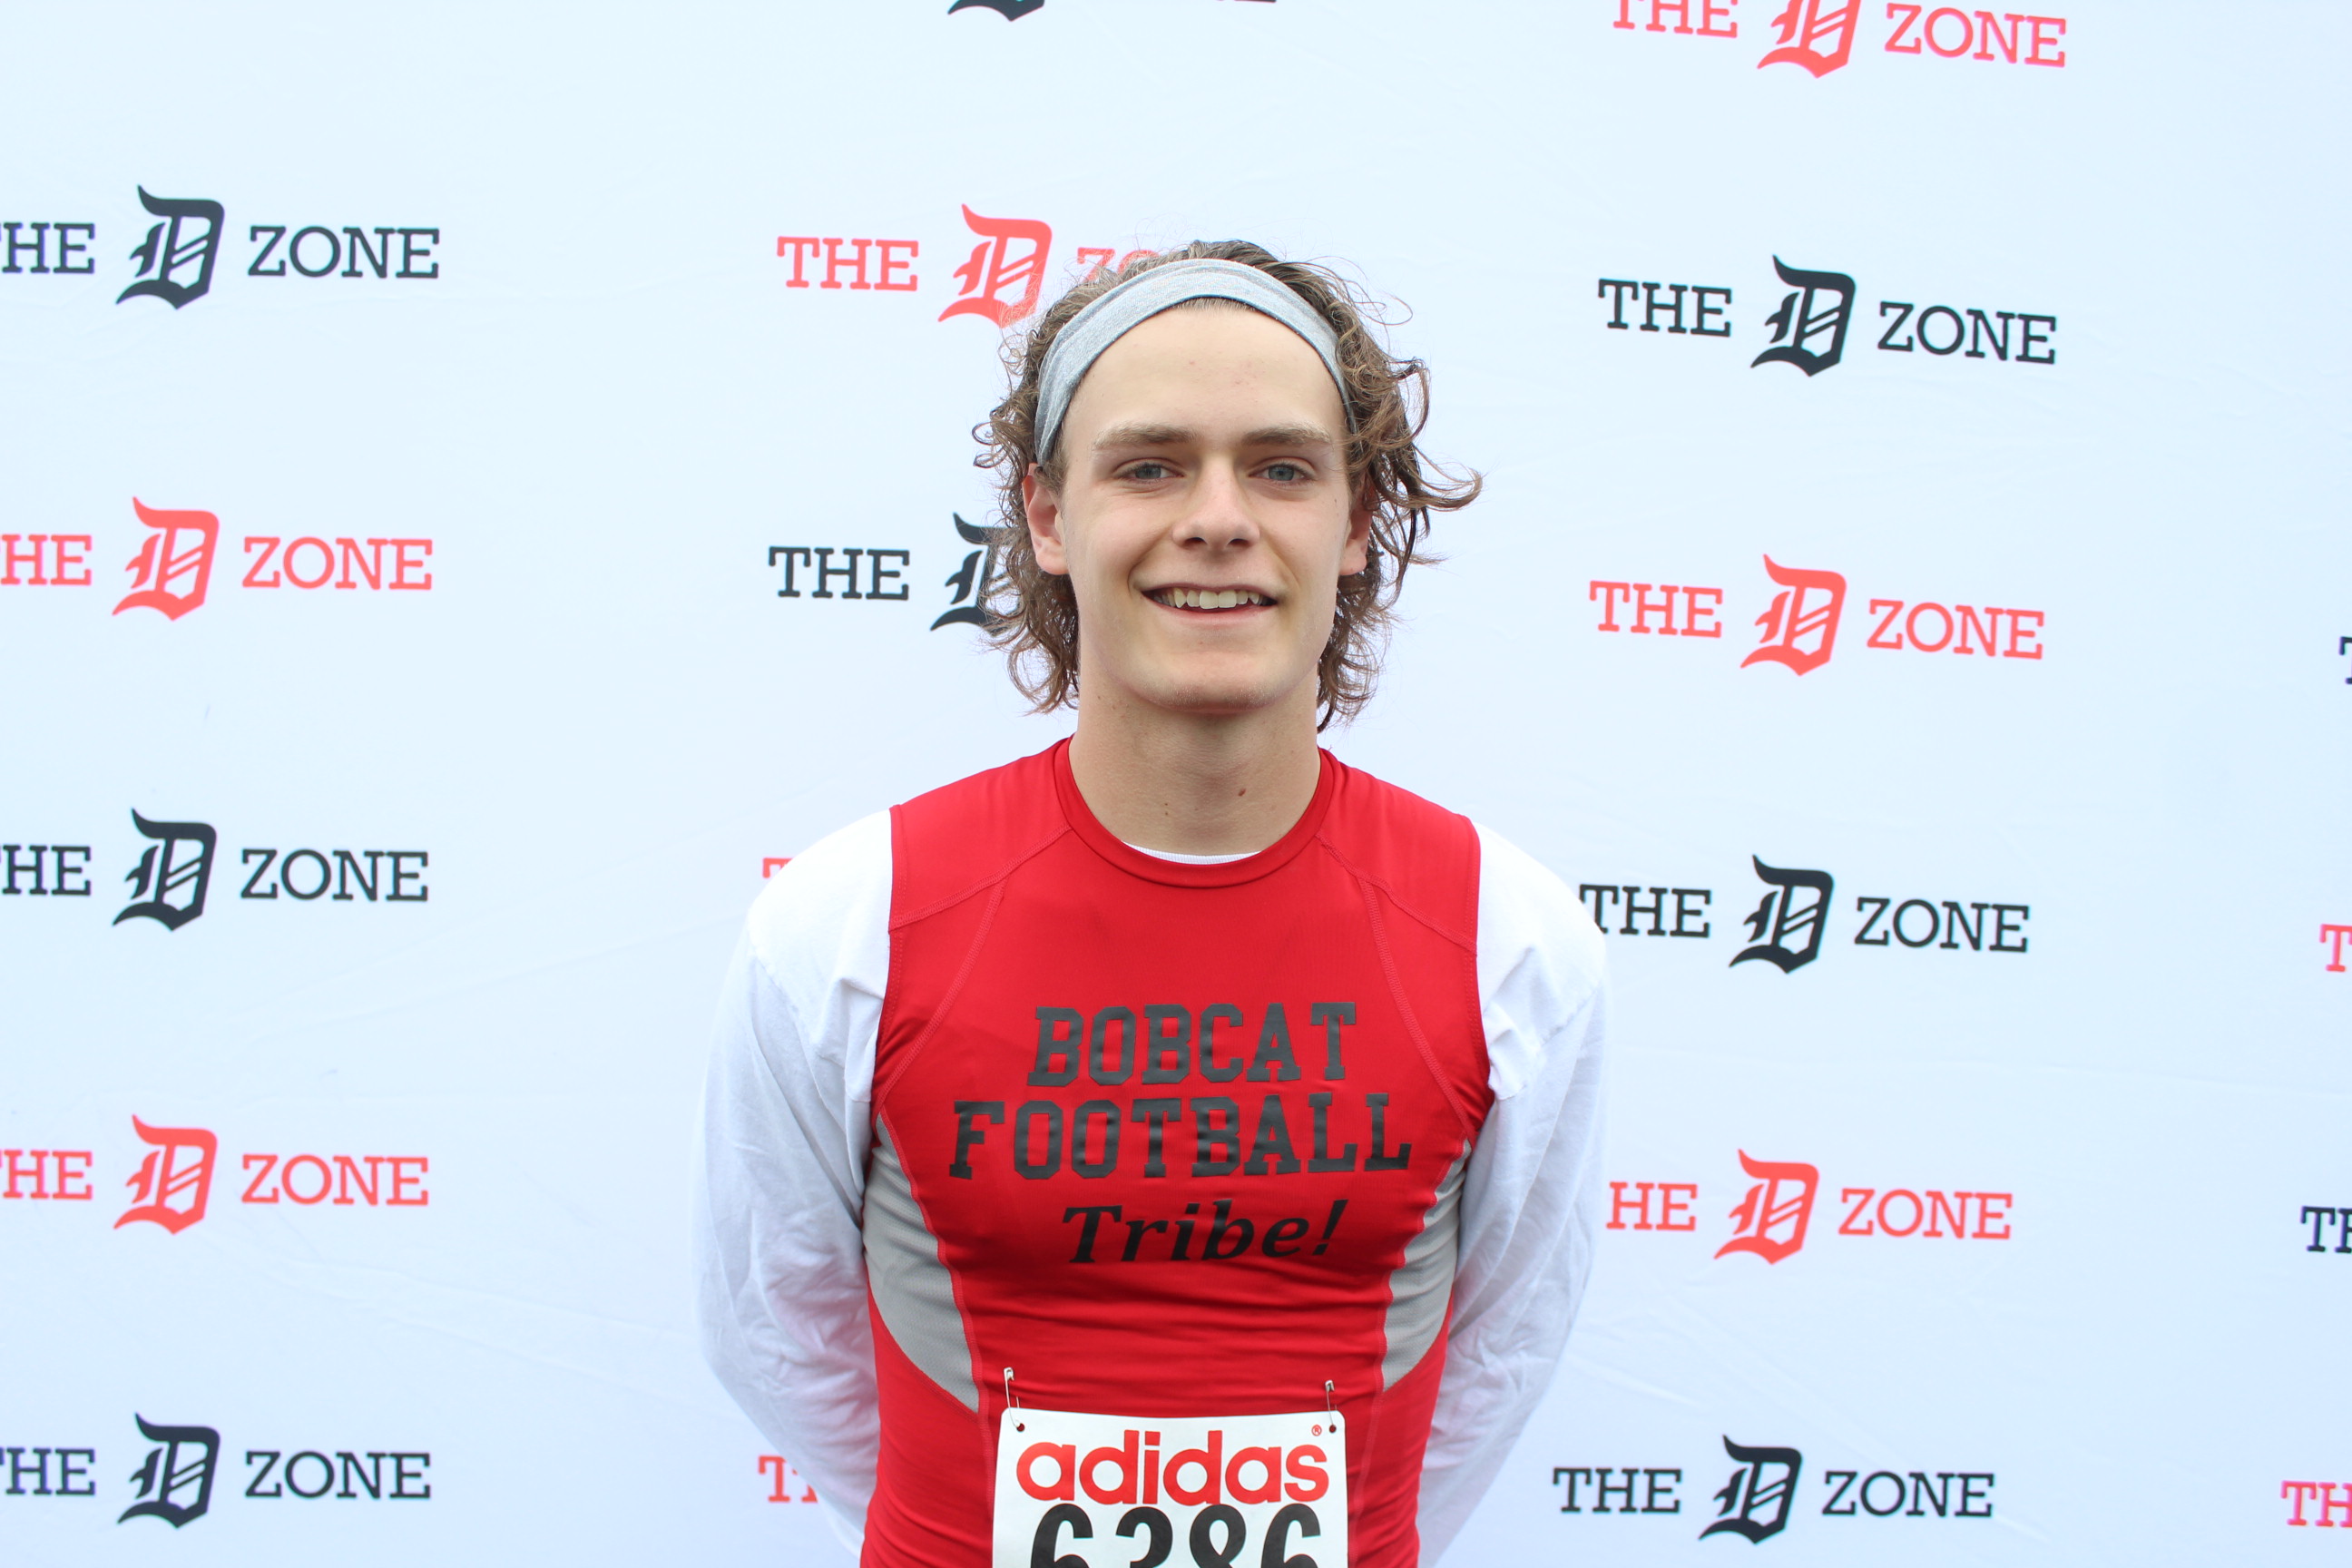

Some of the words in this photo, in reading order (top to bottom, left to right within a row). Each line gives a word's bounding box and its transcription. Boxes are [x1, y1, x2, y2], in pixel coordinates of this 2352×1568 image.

[1758, 0, 1861, 78] D
[1885, 3, 2066, 68] ZONE
[0, 221, 95, 275] HE
[115, 184, 225, 310] D
[247, 224, 440, 279] ZONE
[777, 236, 918, 291] THE
[936, 202, 1054, 329] D
[1597, 277, 1733, 338] THE
[1750, 254, 1857, 377] D
[1877, 299, 2058, 365] ZONE
[0, 534, 92, 586] HE
[113, 497, 220, 621] D
[242, 536, 433, 590] ZONE
[768, 545, 910, 602] THE
[1590, 581, 1722, 638] THE
[1740, 554, 1847, 676] D
[1867, 599, 2044, 660] ZONE
[0, 844, 92, 897] HE
[111, 808, 217, 932] D
[240, 848, 428, 903] ZONE
[1578, 883, 1712, 939] THE
[1729, 854, 1836, 975] D
[1854, 896, 2031, 954] ZONE
[1026, 1001, 1357, 1087] BOBCAT
[0, 1150, 93, 1200] HE
[114, 1115, 218, 1234] D
[241, 1154, 428, 1206] ZONE
[948, 1091, 1413, 1181] FOOTBALL
[1062, 1198, 1348, 1265] Tribe!
[1606, 1181, 1698, 1231] HE
[1714, 1149, 1819, 1265] D
[1838, 1188, 2013, 1240] ZONE
[0, 1446, 96, 1497] HE
[116, 1412, 220, 1530] D
[244, 1450, 431, 1501] ZONE
[1015, 1428, 1330, 1506] adidas
[1552, 1466, 1684, 1515] THE
[1698, 1435, 1804, 1546] D
[1821, 1470, 1996, 1519] ZONE
[2280, 1479, 2352, 1529] TH
